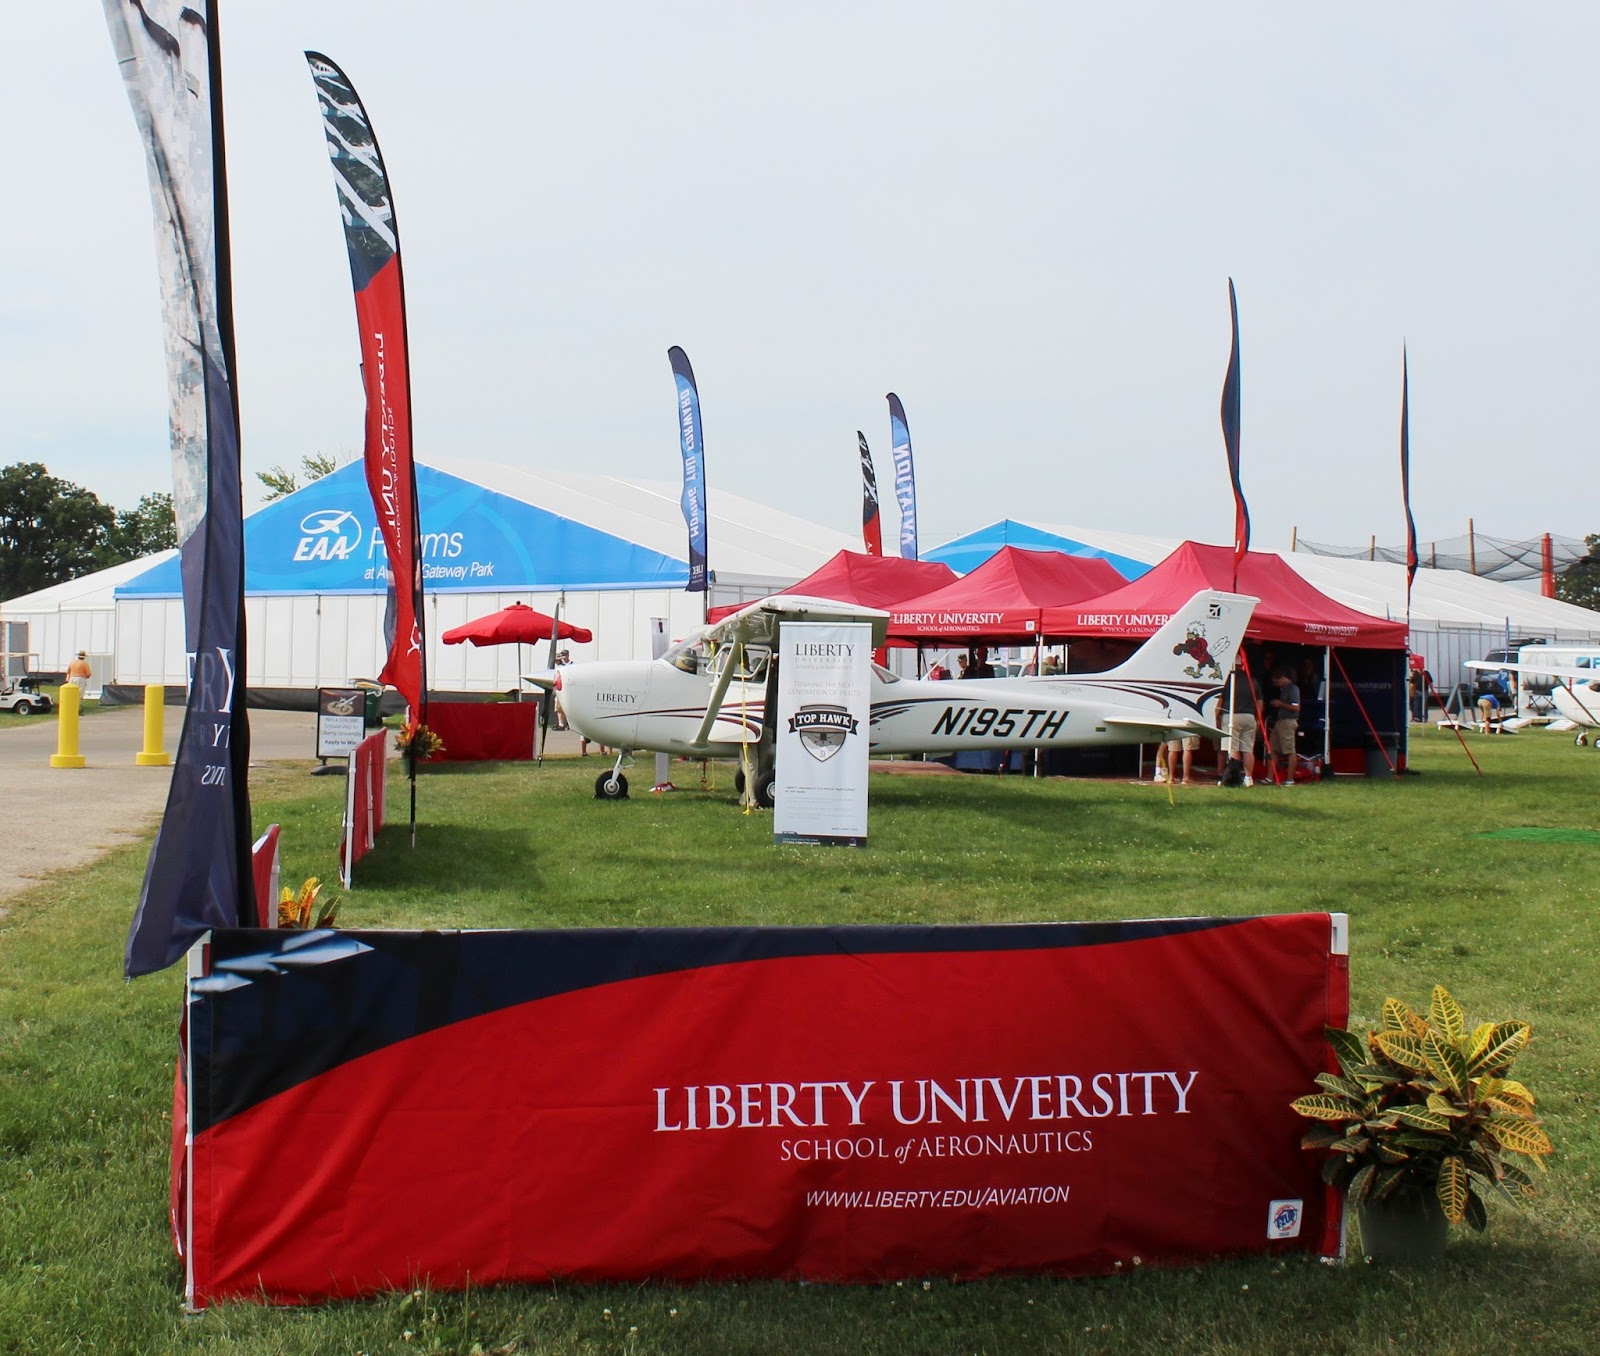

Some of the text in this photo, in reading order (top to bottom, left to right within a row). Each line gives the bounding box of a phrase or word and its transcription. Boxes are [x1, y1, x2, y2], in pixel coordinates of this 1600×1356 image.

[293, 536, 349, 561] EAA
[364, 567, 375, 580] at
[422, 563, 468, 581] Gateway
[470, 561, 495, 578] Park
[893, 612, 1004, 625] LIBERTY UNIVERSITY
[1077, 614, 1175, 626] LIBERTY UNIVERS
[795, 643, 855, 656] LIBERTY
[596, 692, 637, 703] LIBERTY
[797, 713, 850, 726] TOP HAWK
[931, 706, 1070, 739] N195TH
[652, 1070, 1199, 1132] LIBERTY UNIVERSITY
[780, 1130, 1094, 1163] SCHOOL of AERONAUTICS
[806, 1186, 1070, 1208] WWW.LIBERTY.EDU/AVIATION
